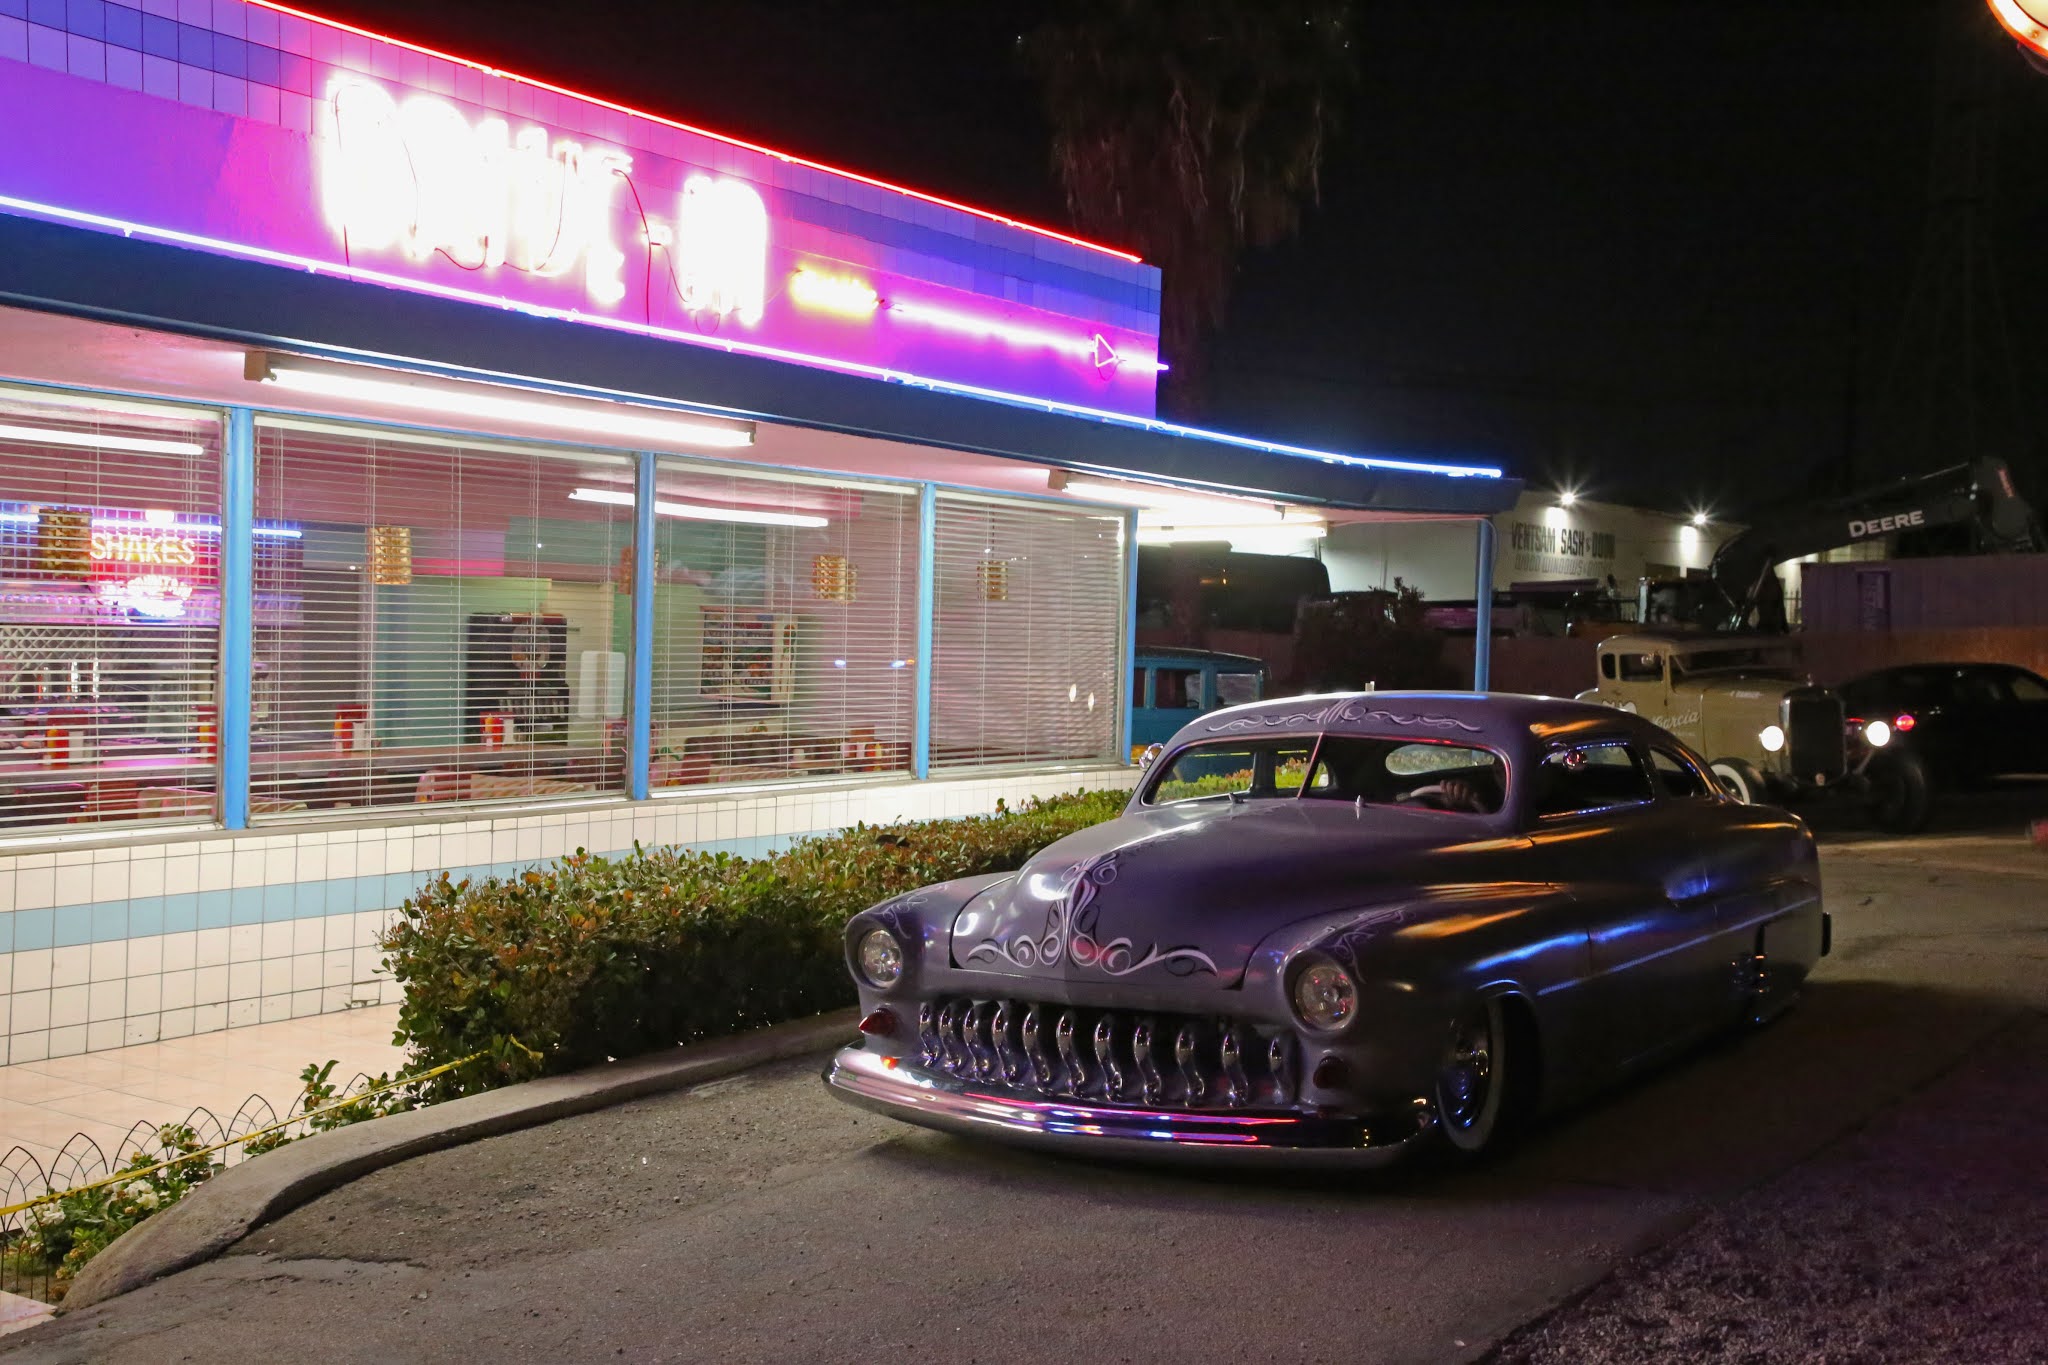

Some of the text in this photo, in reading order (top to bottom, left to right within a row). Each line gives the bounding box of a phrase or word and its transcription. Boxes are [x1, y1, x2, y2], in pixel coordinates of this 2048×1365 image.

[1848, 510, 1925, 537] DEERE
[90, 531, 195, 565] SHAKES
[1560, 528, 1585, 557] SASH
